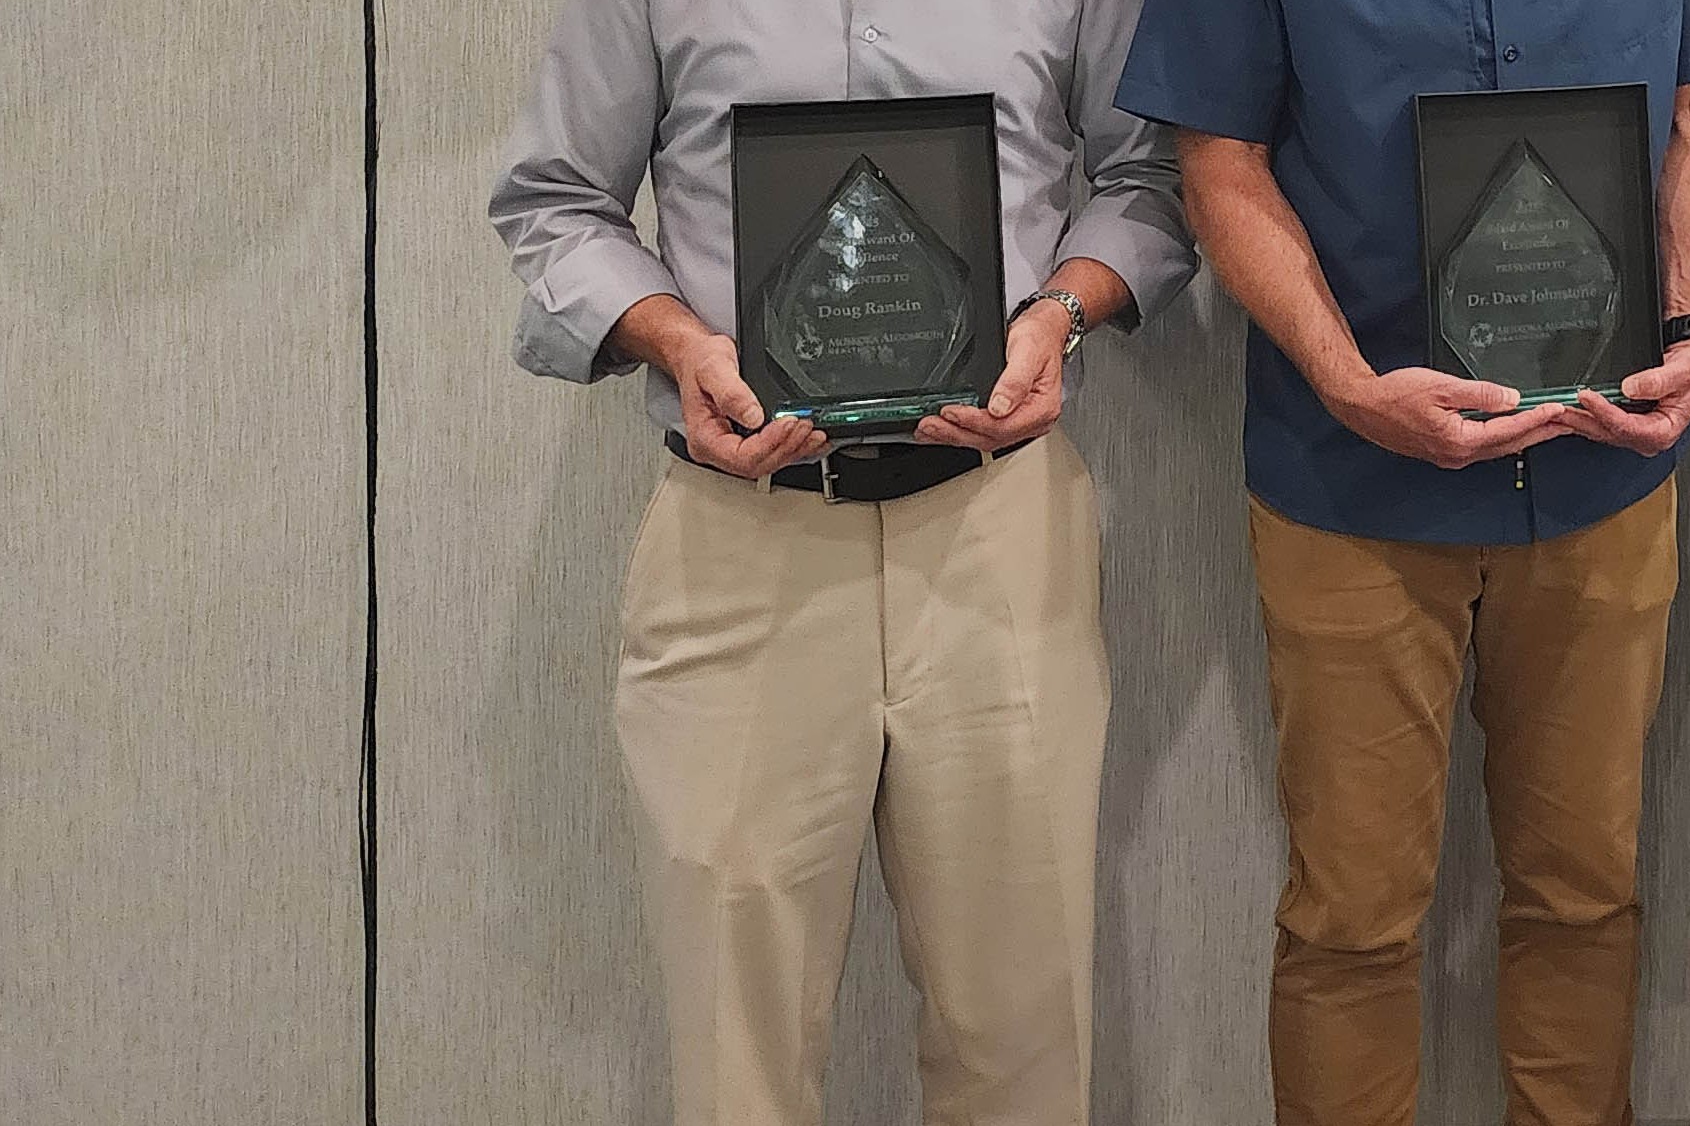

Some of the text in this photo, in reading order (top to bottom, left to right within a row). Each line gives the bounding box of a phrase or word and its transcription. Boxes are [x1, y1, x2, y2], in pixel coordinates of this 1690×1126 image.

[1467, 293, 1489, 307] Dr.
[1493, 291, 1528, 305] Dave
[817, 299, 922, 319] Doug Rankin
